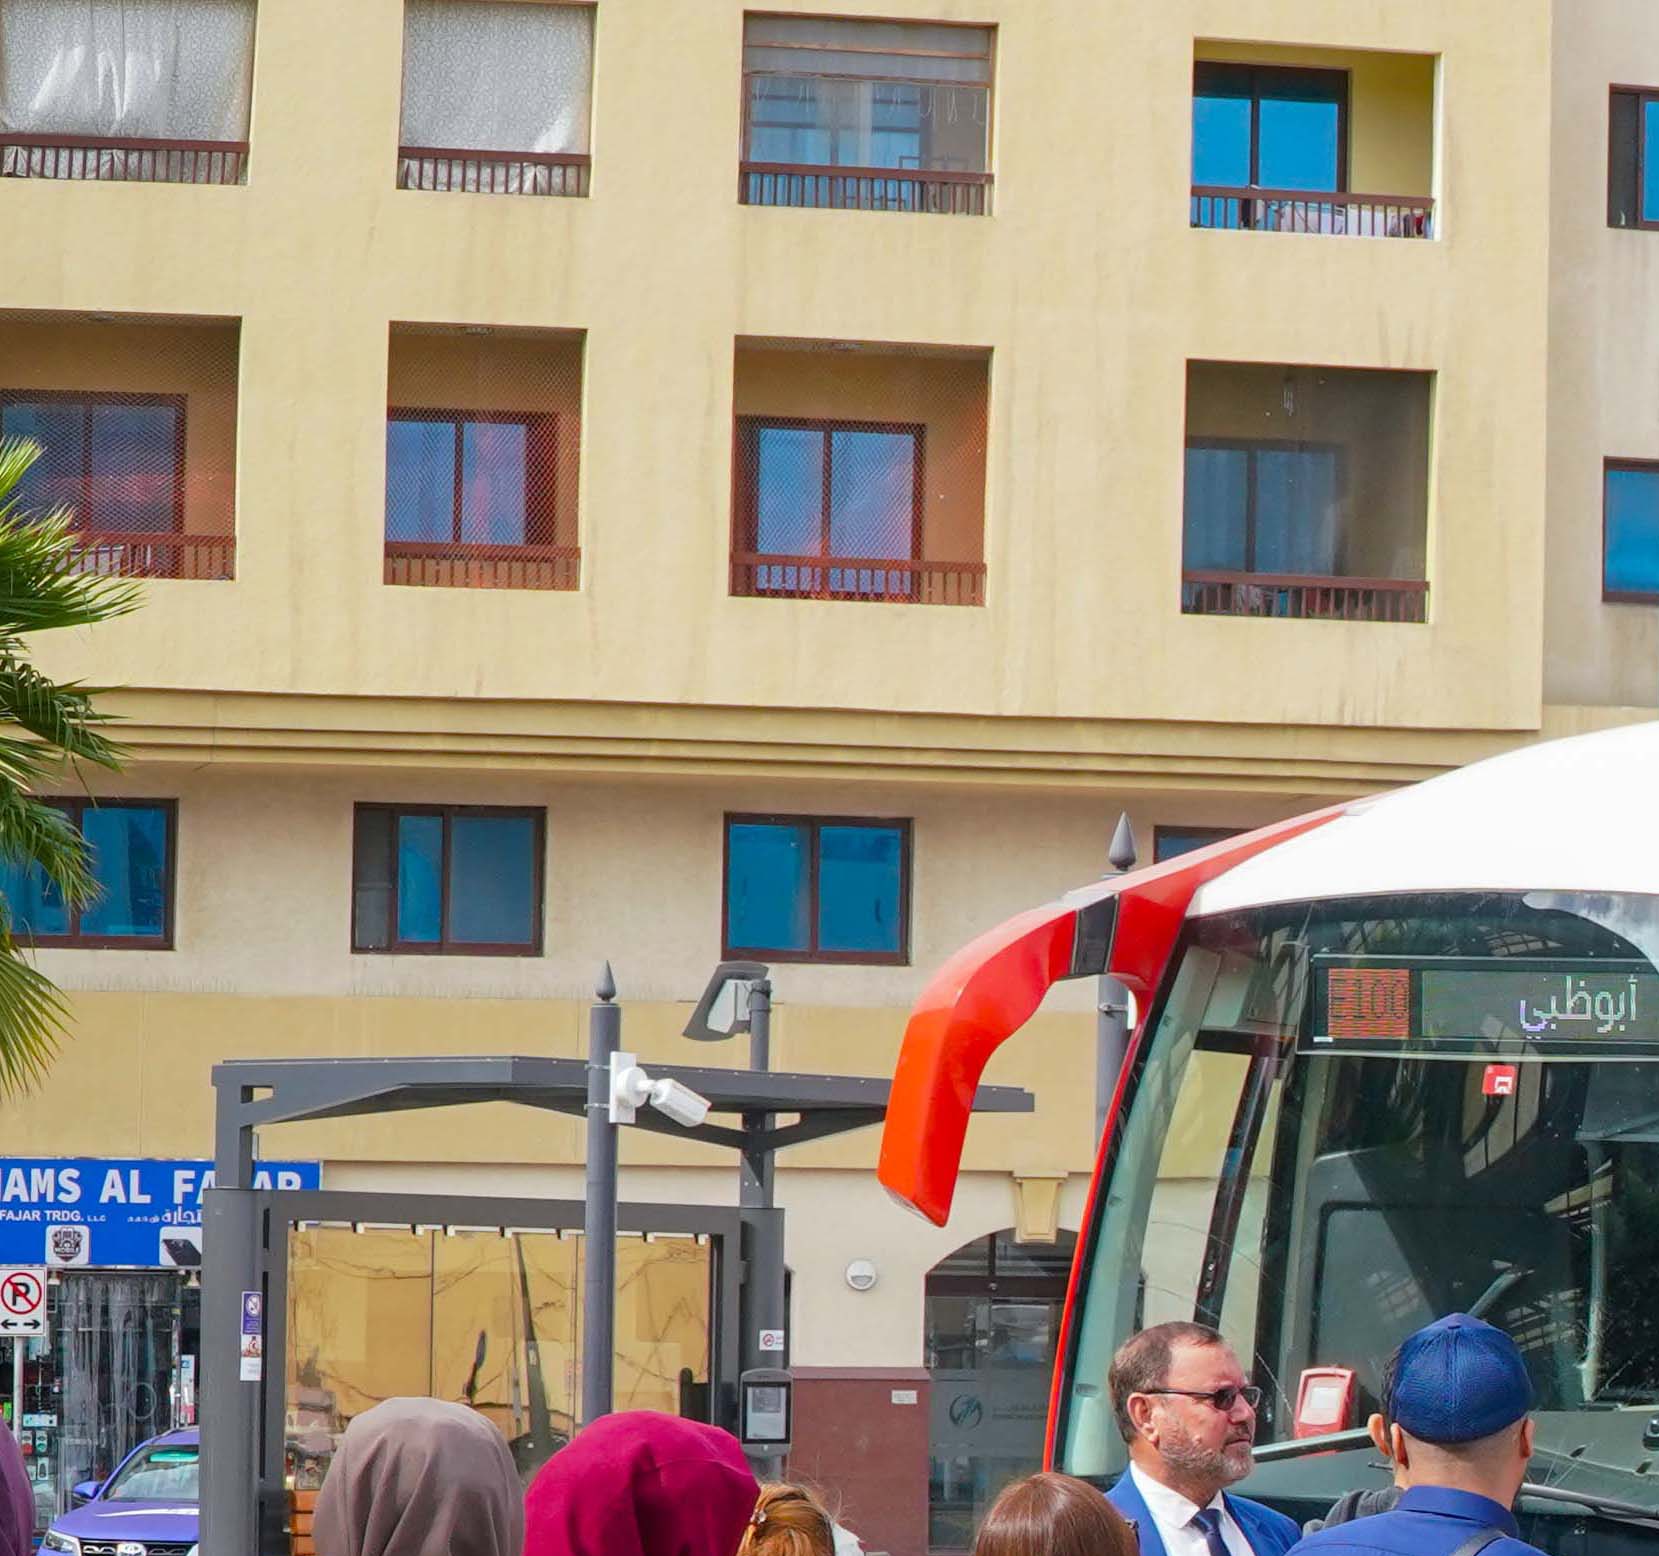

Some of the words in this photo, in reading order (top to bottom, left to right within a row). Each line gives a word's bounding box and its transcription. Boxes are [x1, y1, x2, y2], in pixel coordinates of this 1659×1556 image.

[0, 1167, 82, 1204] AMS
[99, 1169, 152, 1204] AL
[173, 1169, 302, 1205] FAAR
[0, 1209, 41, 1222] FAJAR
[44, 1209, 84, 1222] TRDG.
